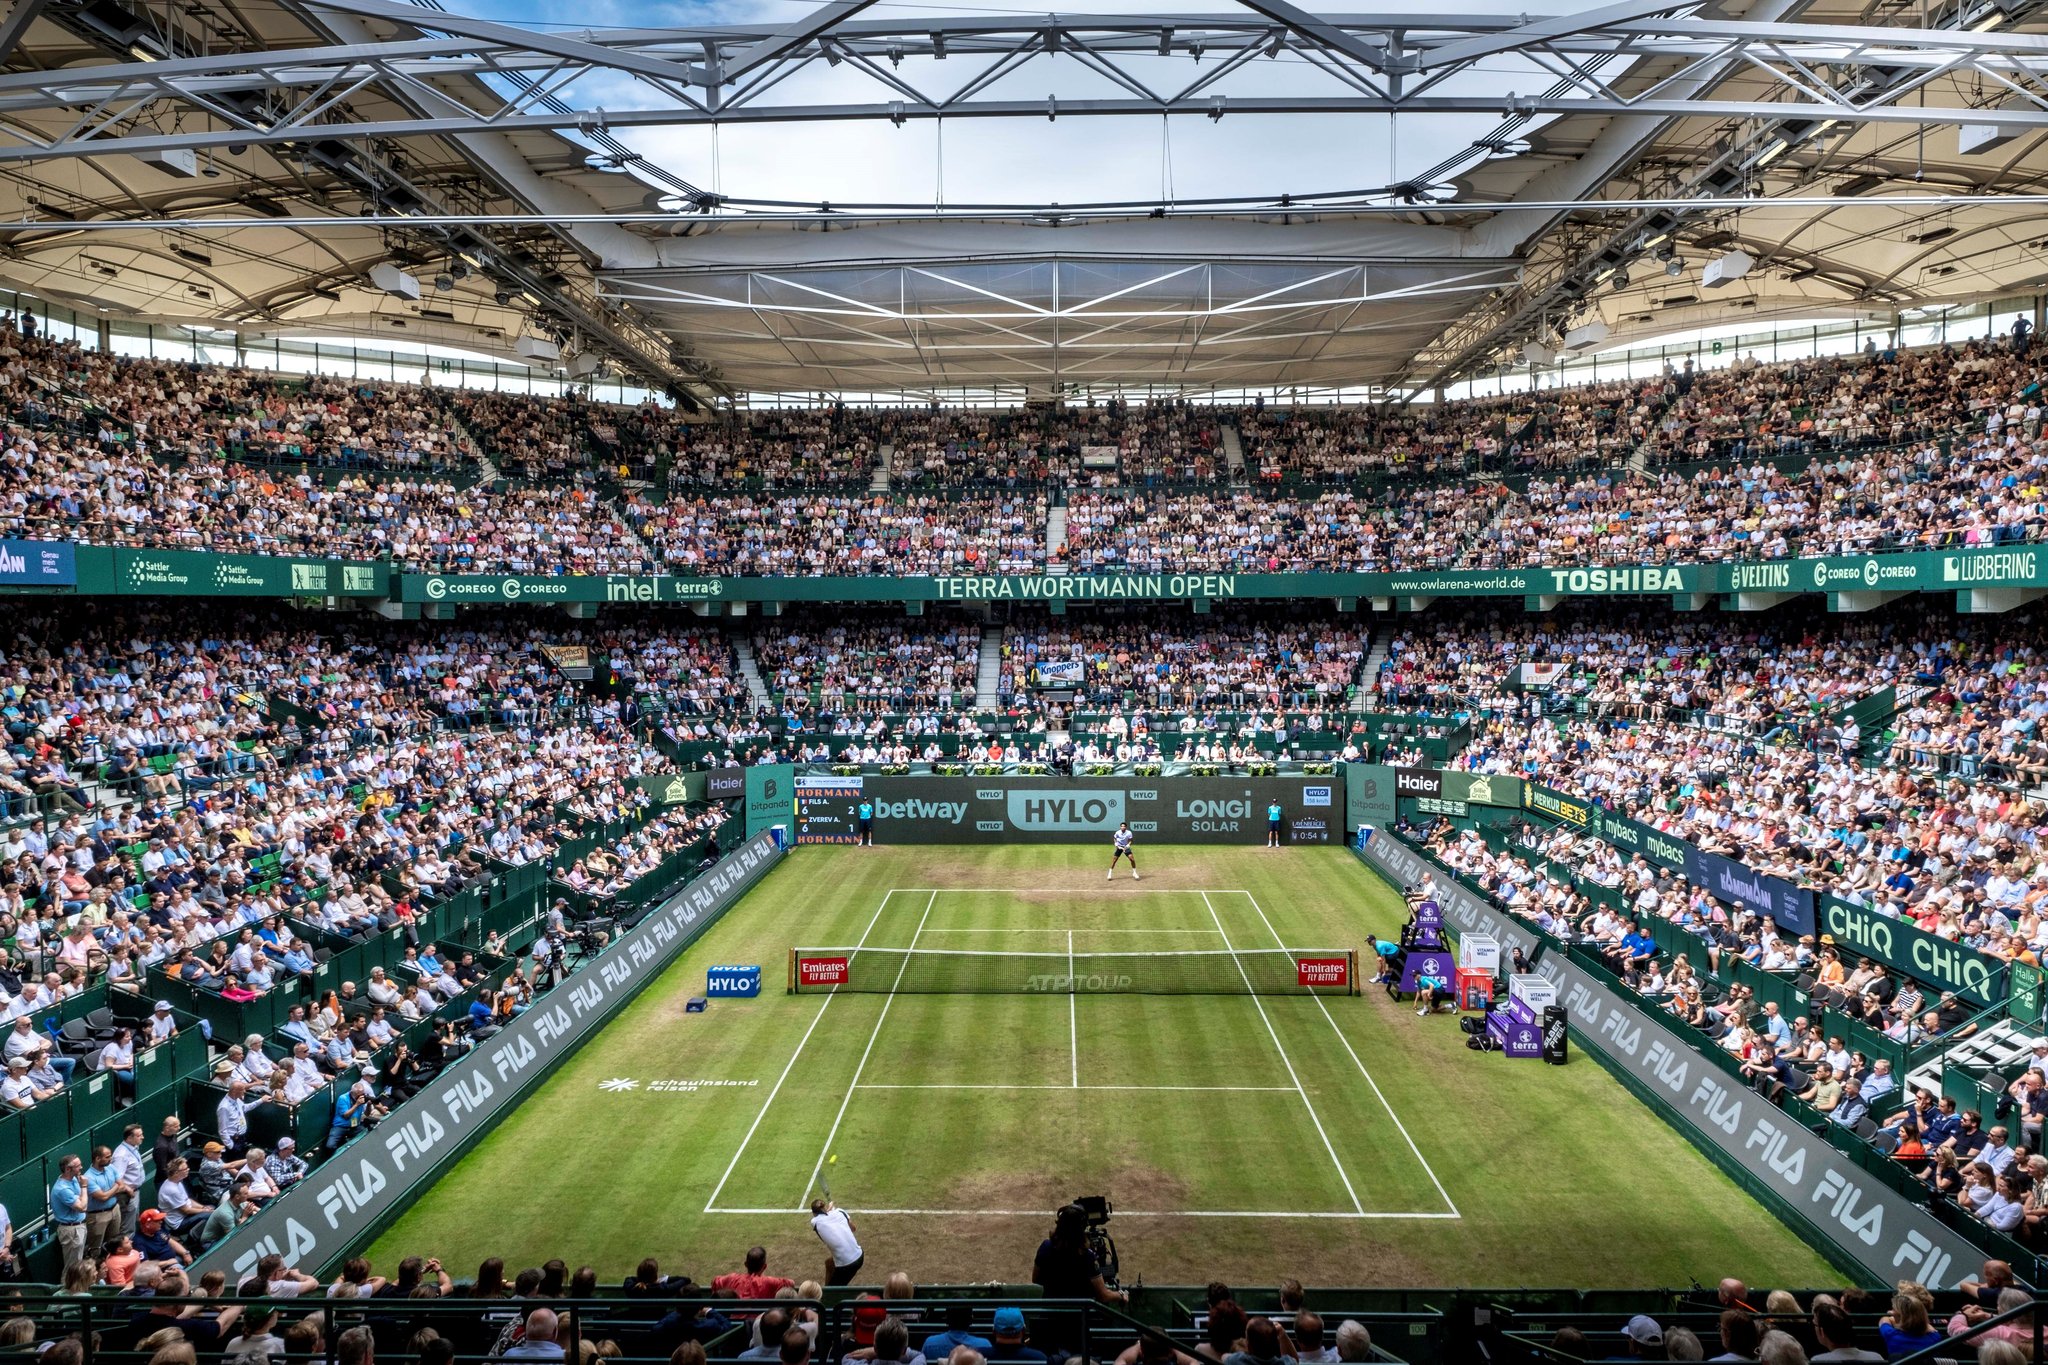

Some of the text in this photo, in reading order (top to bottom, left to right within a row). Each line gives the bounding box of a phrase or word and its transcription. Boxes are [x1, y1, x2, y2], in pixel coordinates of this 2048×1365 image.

[1713, 342, 1722, 355] B
[442, 361, 450, 373] H
[42, 550, 60, 558] Genau
[146, 561, 170, 571] Sattler
[228, 565, 248, 574] Sattler
[1740, 564, 1789, 588] VELTINS
[1828, 568, 1860, 580] COREGO
[1880, 566, 1916, 578] COREGO
[1962, 552, 2035, 581] LÜBBERING
[146, 572, 188, 584] Media Group
[228, 576, 264, 586] Media Group
[675, 582, 708, 593] terra
[934, 576, 1235, 598] TERRA WORTMANN OPEN
[1391, 576, 1526, 591] www.owlarena-world.de
[1551, 569, 1684, 592] TOSHIBA
[450, 585, 496, 594] COREGO
[524, 584, 567, 594] COREGO
[1041, 662, 1080, 676] Knoppers
[710, 778, 742, 790] Haier
[1398, 774, 1439, 791] Haier
[752, 800, 789, 811] bitpanda
[875, 798, 968, 824] betway
[1352, 800, 1390, 811] bitpanda
[1534, 792, 1560, 812] MERKUR
[1560, 802, 1586, 822] BETS
[802, 824, 853, 832] 6 1
[1192, 822, 1239, 832] SOLAR
[1606, 819, 1638, 844] mybacs
[754, 840, 770, 860] FILA
[1374, 838, 1388, 858] FILA
[1647, 836, 1684, 864] mybacs
[741, 849, 758, 871] FILA
[1387, 849, 1403, 871] FILA
[726, 861, 745, 884] FILA
[1401, 859, 1420, 885] FILA
[710, 873, 730, 897] FILA
[1720, 866, 1772, 910] KAMPMANN
[692, 886, 714, 912] FILA
[1784, 892, 1799, 905] Genau
[1784, 902, 1797, 912] mein
[672, 901, 696, 928] FILA
[1454, 899, 1478, 928] FILA
[652, 916, 678, 947] FILA
[628, 934, 656, 968] FILA
[601, 955, 632, 992] FILA
[802, 962, 845, 973] Emirates
[809, 972, 839, 980] FLY BETTER
[1301, 963, 1344, 973] Emirates
[1307, 973, 1338, 982] FLY BETTER
[2016, 966, 2034, 983] Halle
[1022, 974, 1133, 991] ATP TOUR
[568, 978, 604, 1018] FILA
[1564, 982, 1601, 1024] FILA
[2024, 1000, 2033, 1009] 500
[533, 1004, 572, 1048] FILA
[1601, 1009, 1641, 1056] FILA
[491, 1034, 537, 1082] FILA
[1642, 1040, 1688, 1092] FILA
[442, 1069, 494, 1124] FILA
[1690, 1077, 1742, 1135] FILA
[385, 1110, 445, 1172] FILA
[1746, 1118, 1806, 1185] FILA
[316, 1158, 387, 1229] FILA
[1812, 1168, 1884, 1246] FILA
